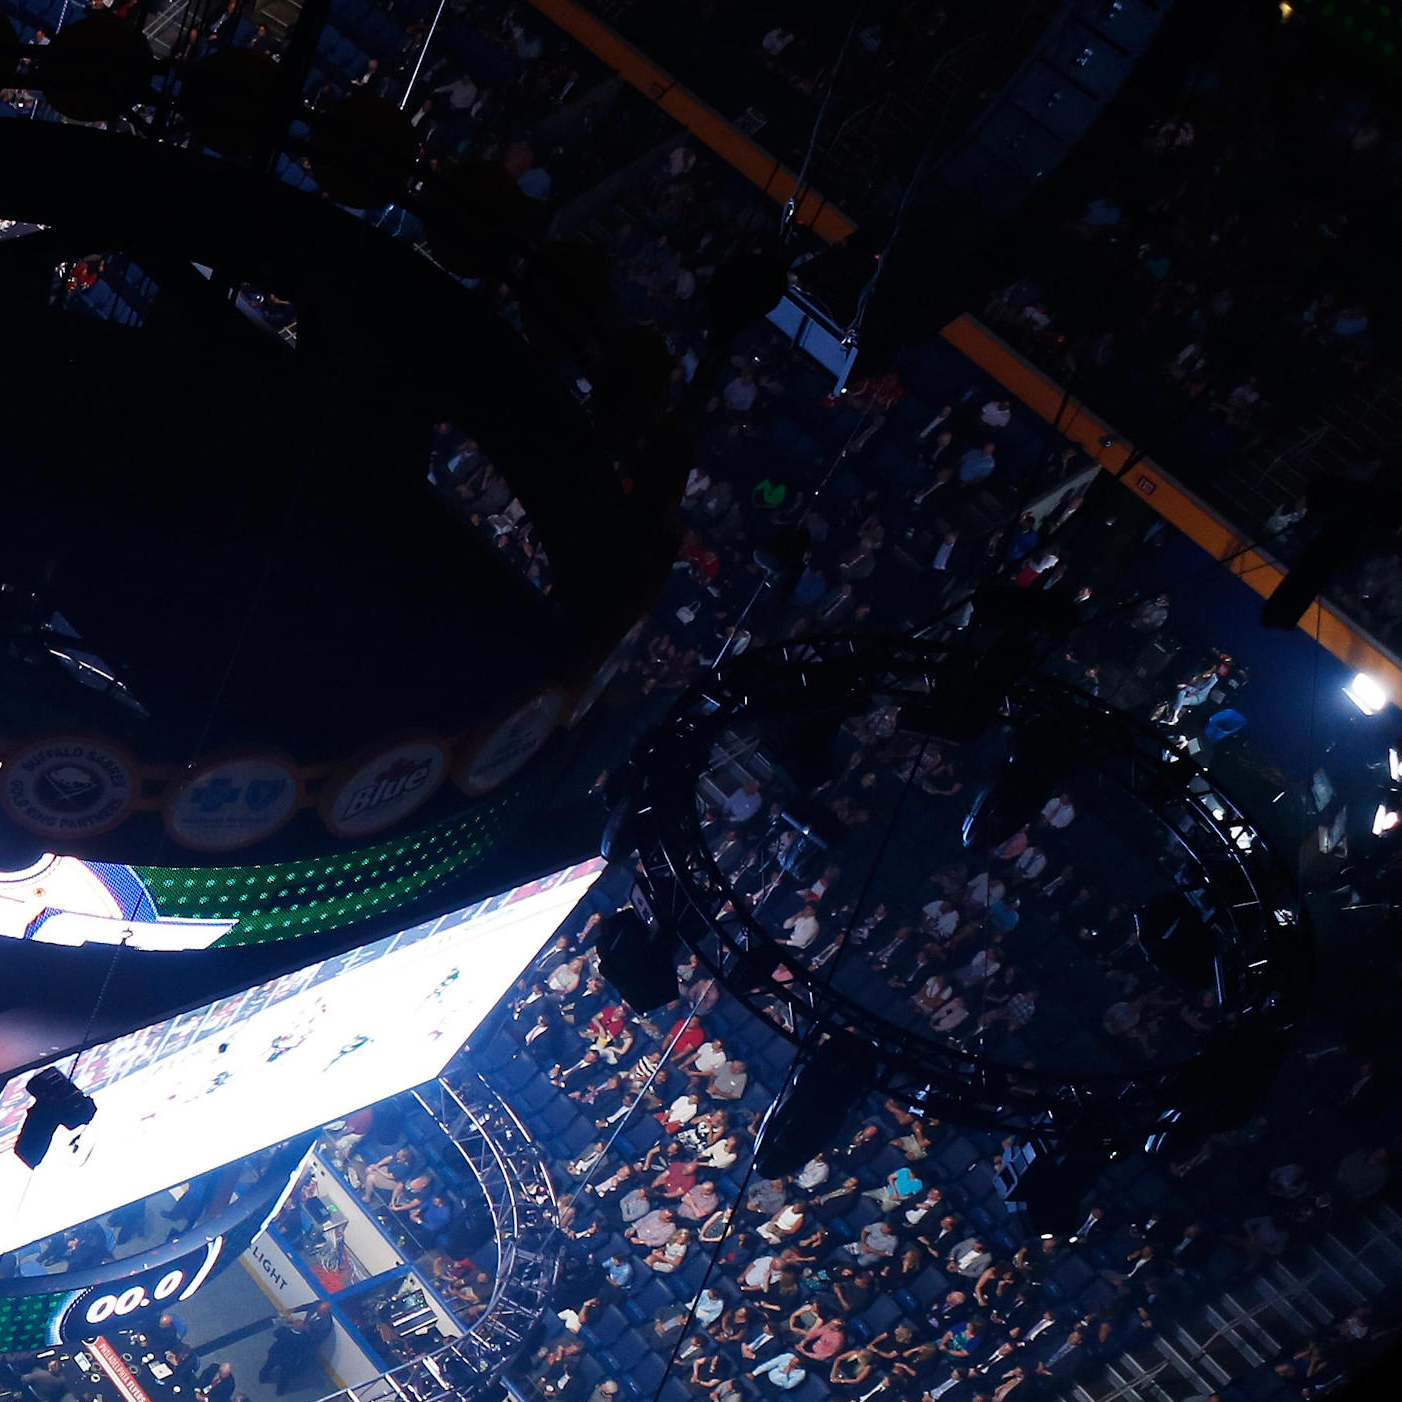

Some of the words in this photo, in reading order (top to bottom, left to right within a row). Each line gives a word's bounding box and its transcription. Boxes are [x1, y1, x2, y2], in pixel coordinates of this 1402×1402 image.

[23, 748, 85, 772] BUFFALO
[350, 766, 432, 811] Blue
[252, 1246, 288, 1290] LIGHT
[97, 1342, 131, 1383] PHILADELPHIA
